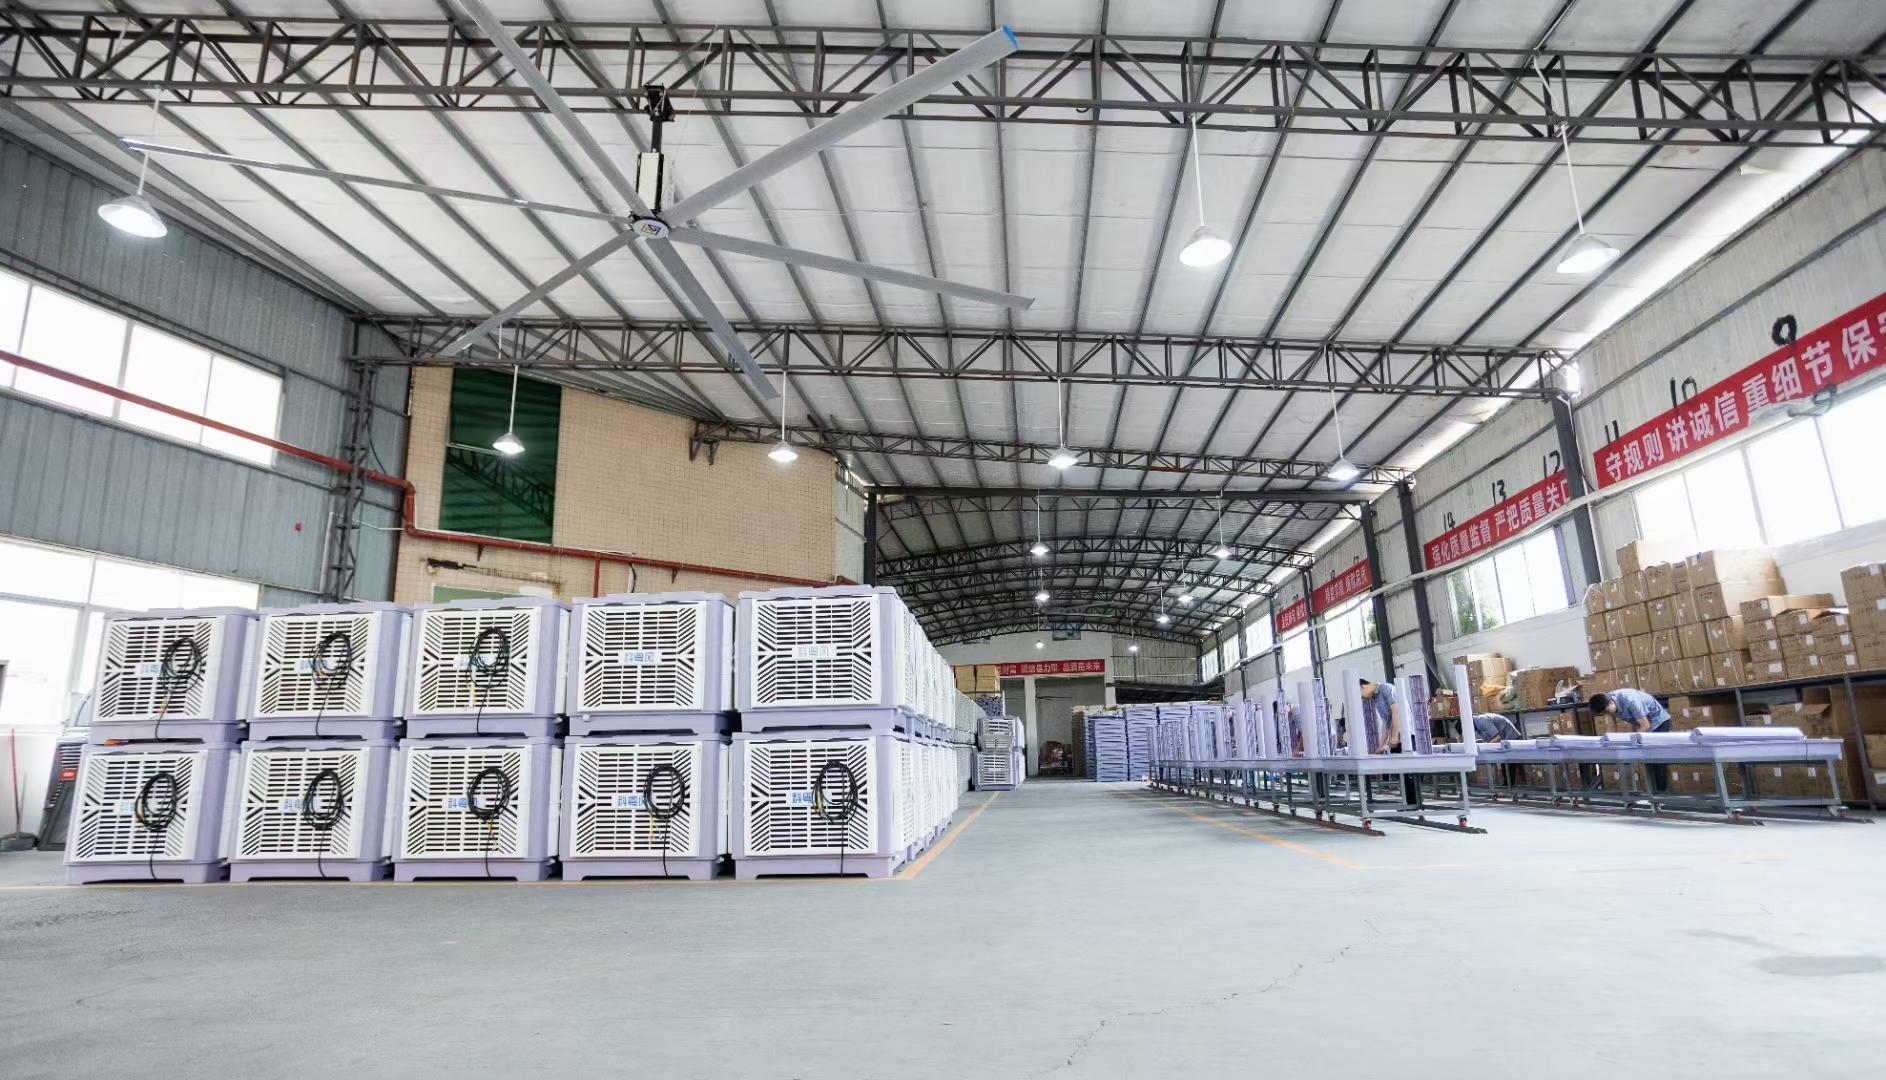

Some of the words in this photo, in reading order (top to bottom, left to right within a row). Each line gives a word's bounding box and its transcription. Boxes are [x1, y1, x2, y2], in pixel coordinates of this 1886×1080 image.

[1841, 311, 1886, 371] 保
[1431, 518, 1492, 568] 强化质量监督
